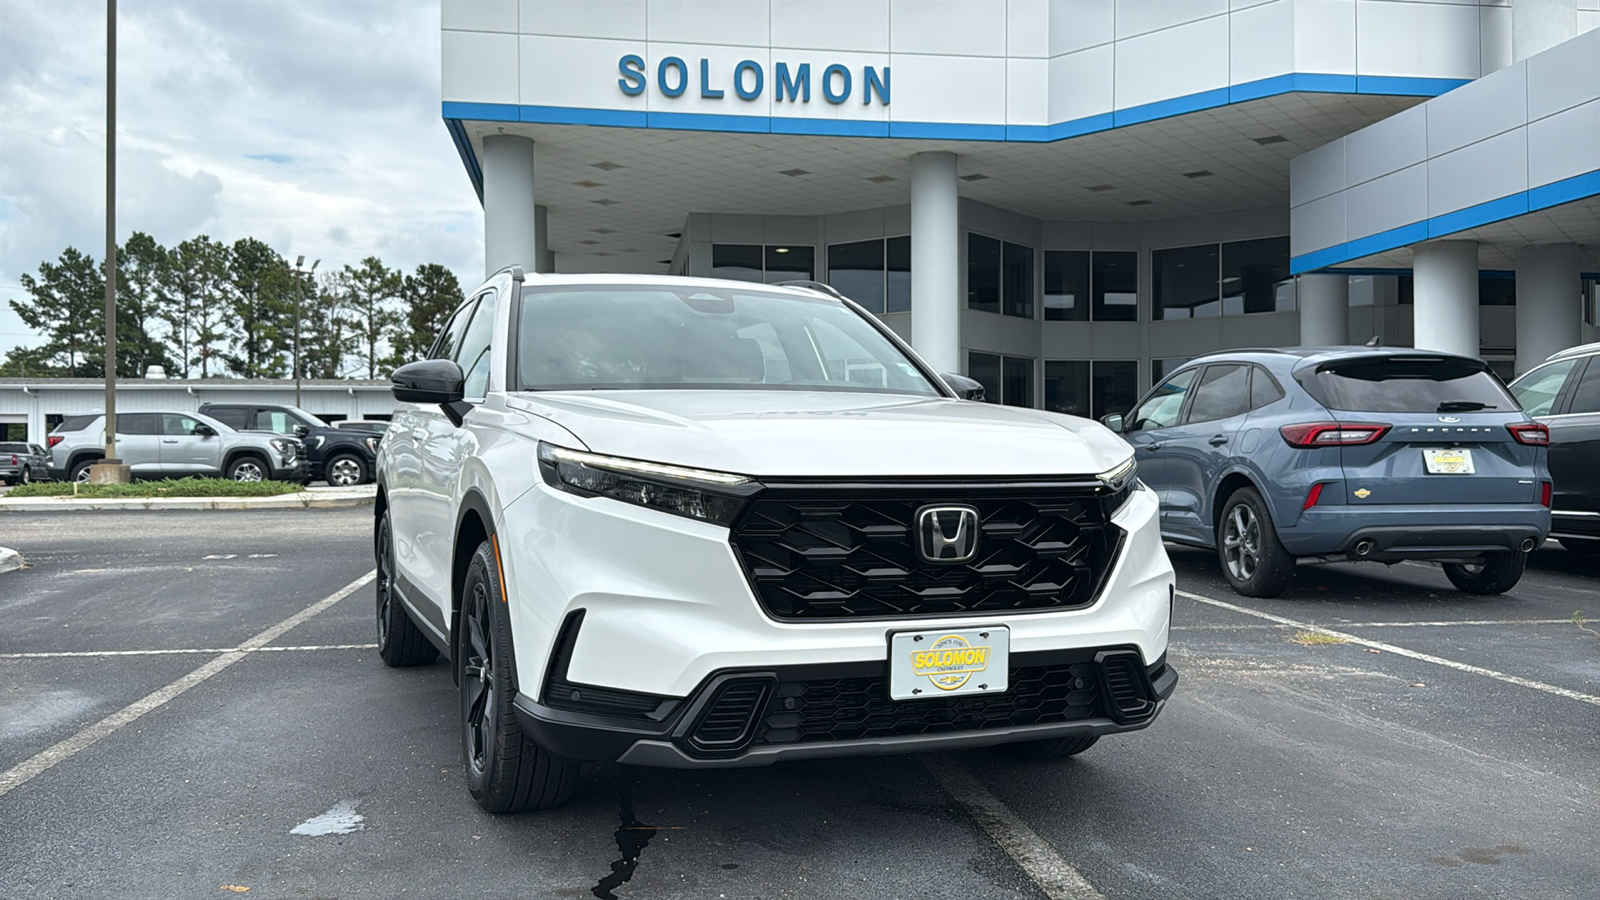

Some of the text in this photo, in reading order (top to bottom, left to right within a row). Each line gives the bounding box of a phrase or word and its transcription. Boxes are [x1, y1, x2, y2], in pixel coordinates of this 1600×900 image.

[618, 54, 891, 106] SOLOMON
[936, 639, 952, 648] SINCE
[915, 649, 986, 669] SOLOMON
